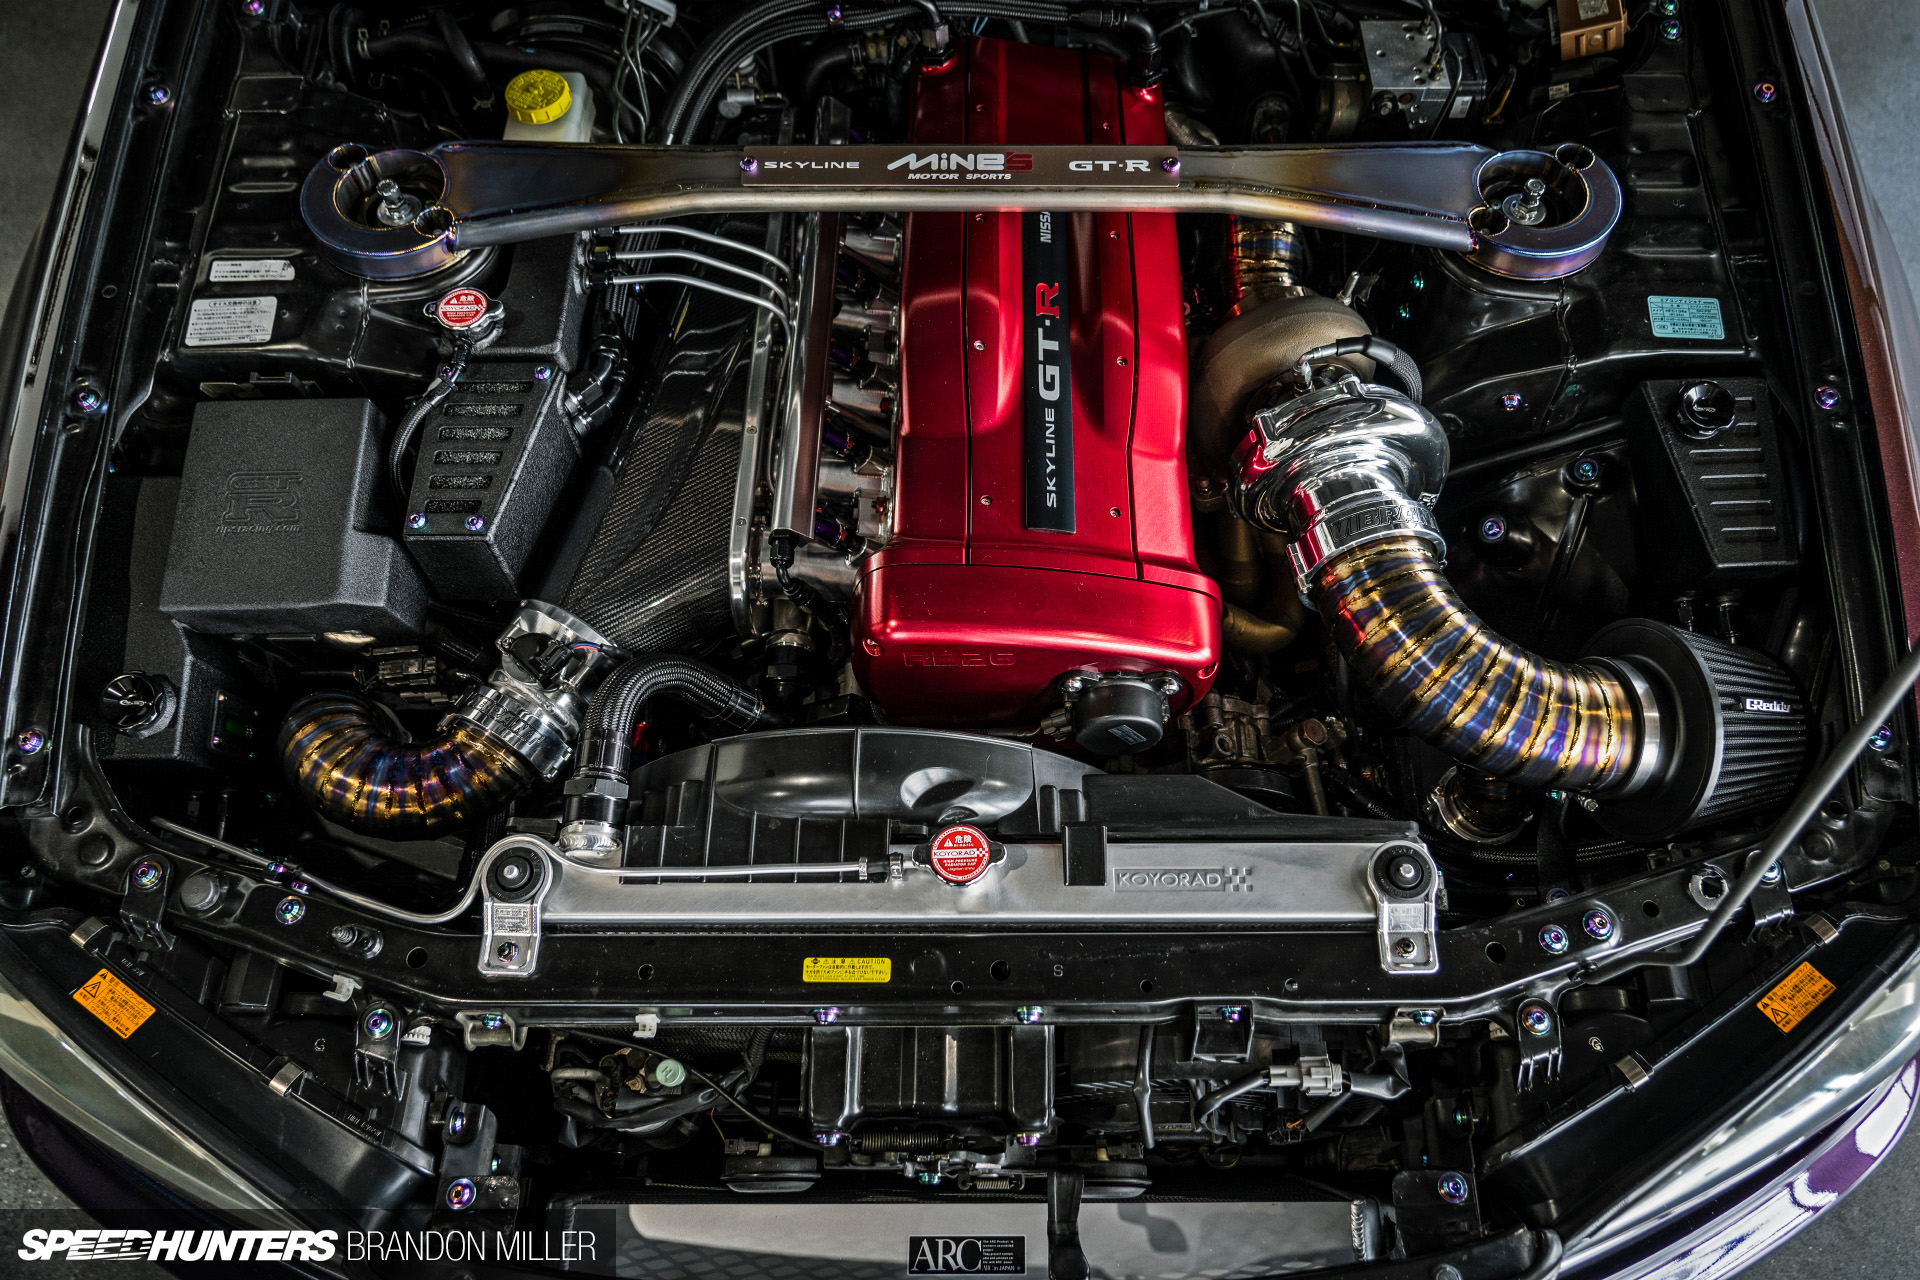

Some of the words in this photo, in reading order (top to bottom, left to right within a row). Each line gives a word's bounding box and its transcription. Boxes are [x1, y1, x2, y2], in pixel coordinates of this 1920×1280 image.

[763, 161, 860, 169] SKYLINE
[1045, 407, 1057, 508] SKYLINE
[903, 651, 1017, 667] RB26
[1746, 698, 1791, 713] GReddy
[954, 834, 973, 844] 危険
[1118, 872, 1222, 888] KOYORAD
[910, 1238, 982, 1271] ARC
